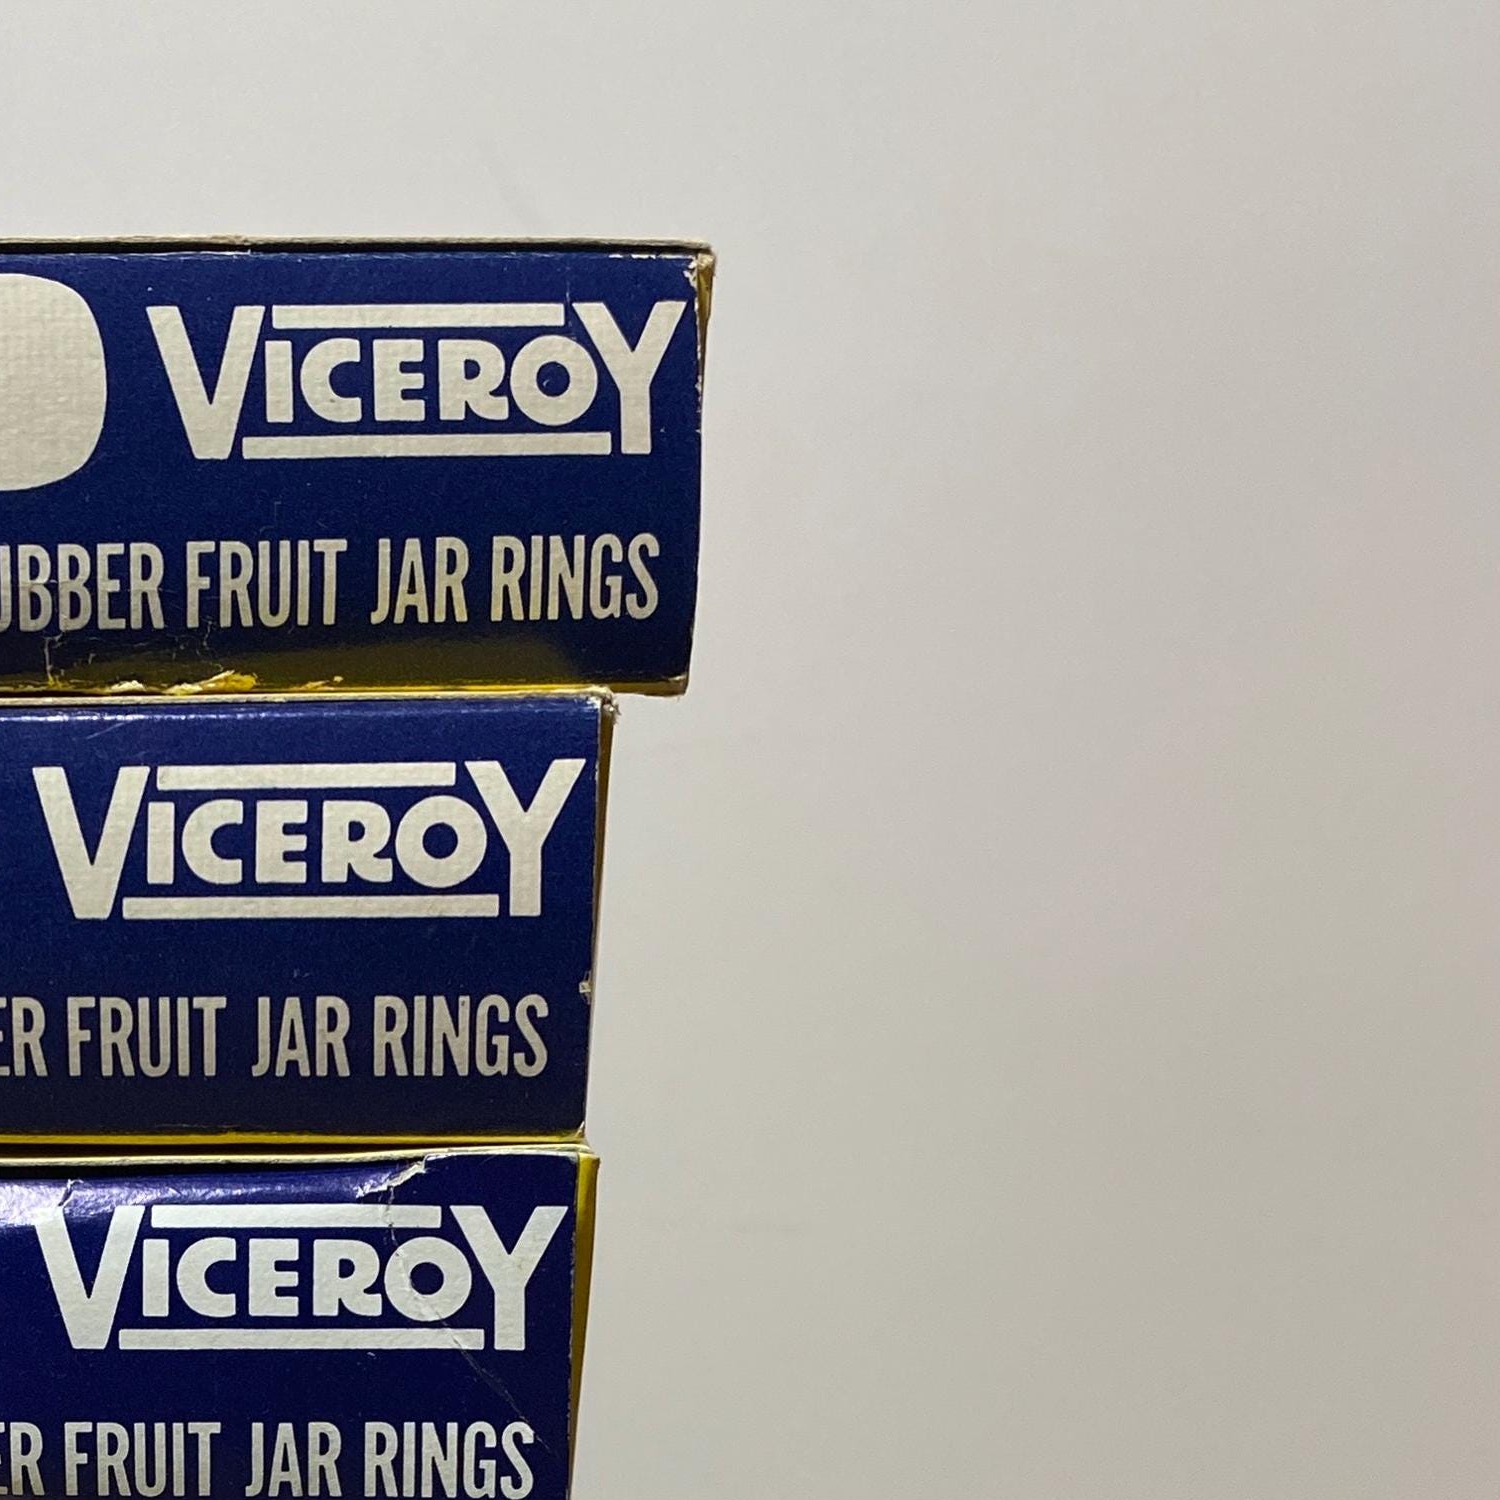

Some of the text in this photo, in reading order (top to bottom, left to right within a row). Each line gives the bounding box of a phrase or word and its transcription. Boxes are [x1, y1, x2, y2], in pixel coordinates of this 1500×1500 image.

[145, 299, 687, 460] VICEROY
[187, 538, 348, 628] FRUIT
[369, 536, 469, 625] JAR
[490, 531, 661, 622] RINGS
[31, 757, 586, 920] VICEROY
[68, 996, 228, 1078] FRUIT
[251, 995, 351, 1078] JAR
[373, 994, 549, 1078] RINGS
[30, 1203, 568, 1351] VICEROY
[63, 1421, 222, 1498] FRUIT
[244, 1421, 344, 1498] JAR
[364, 1421, 535, 1500] RINGS
